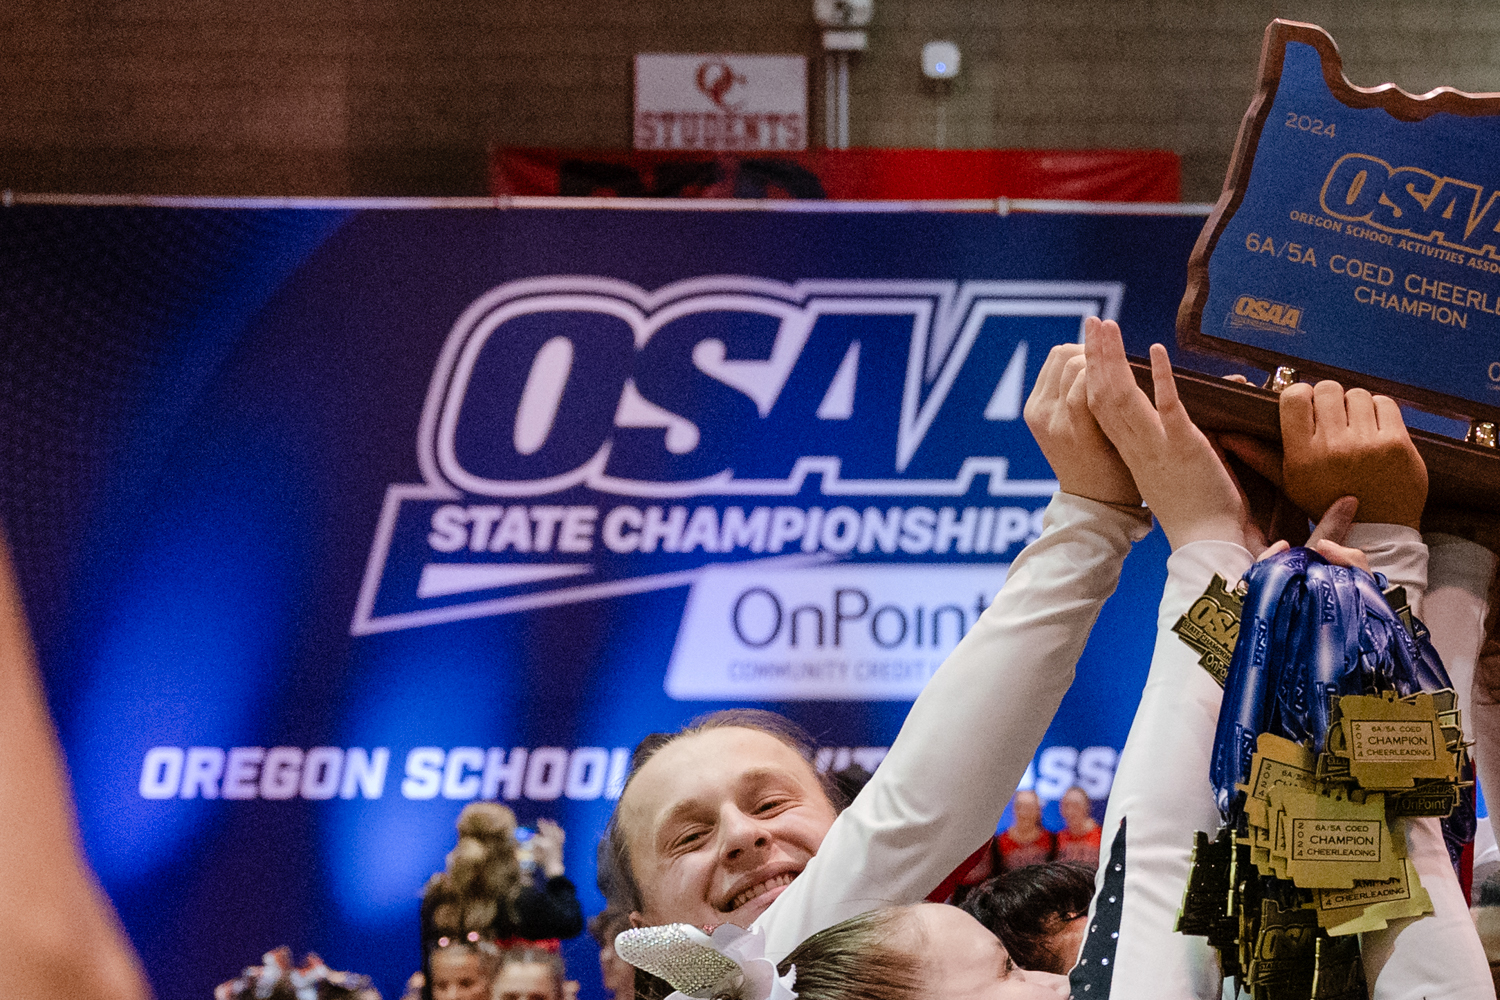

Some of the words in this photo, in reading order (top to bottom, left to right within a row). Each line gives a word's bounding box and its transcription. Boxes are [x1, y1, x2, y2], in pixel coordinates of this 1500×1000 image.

[634, 111, 802, 150] STUDENTS
[1285, 112, 1337, 139] 2024
[1289, 210, 1342, 233] OREGON
[1345, 224, 1394, 246] SCHOOL
[1397, 239, 1464, 265] ACTIVITIES
[1245, 232, 1318, 268] 6A/5A
[1329, 254, 1395, 286] COED
[1235, 296, 1300, 329] OSAA
[1353, 286, 1468, 329] CHAMPION
[428, 285, 1112, 498] OSAA
[428, 505, 597, 553] STATE
[1367, 736, 1428, 746] CHAMPION
[1399, 725, 1422, 733] COED
[1366, 748, 1431, 757] CHEERLEADING
[138, 746, 390, 800] OREGON
[1401, 798, 1448, 811] OnPoint
[1309, 835, 1374, 846] CHAMPION
[1345, 824, 1369, 832] COED
[1306, 848, 1376, 858] CHEERLEADING
[1334, 887, 1406, 904] CHEERLEADING
